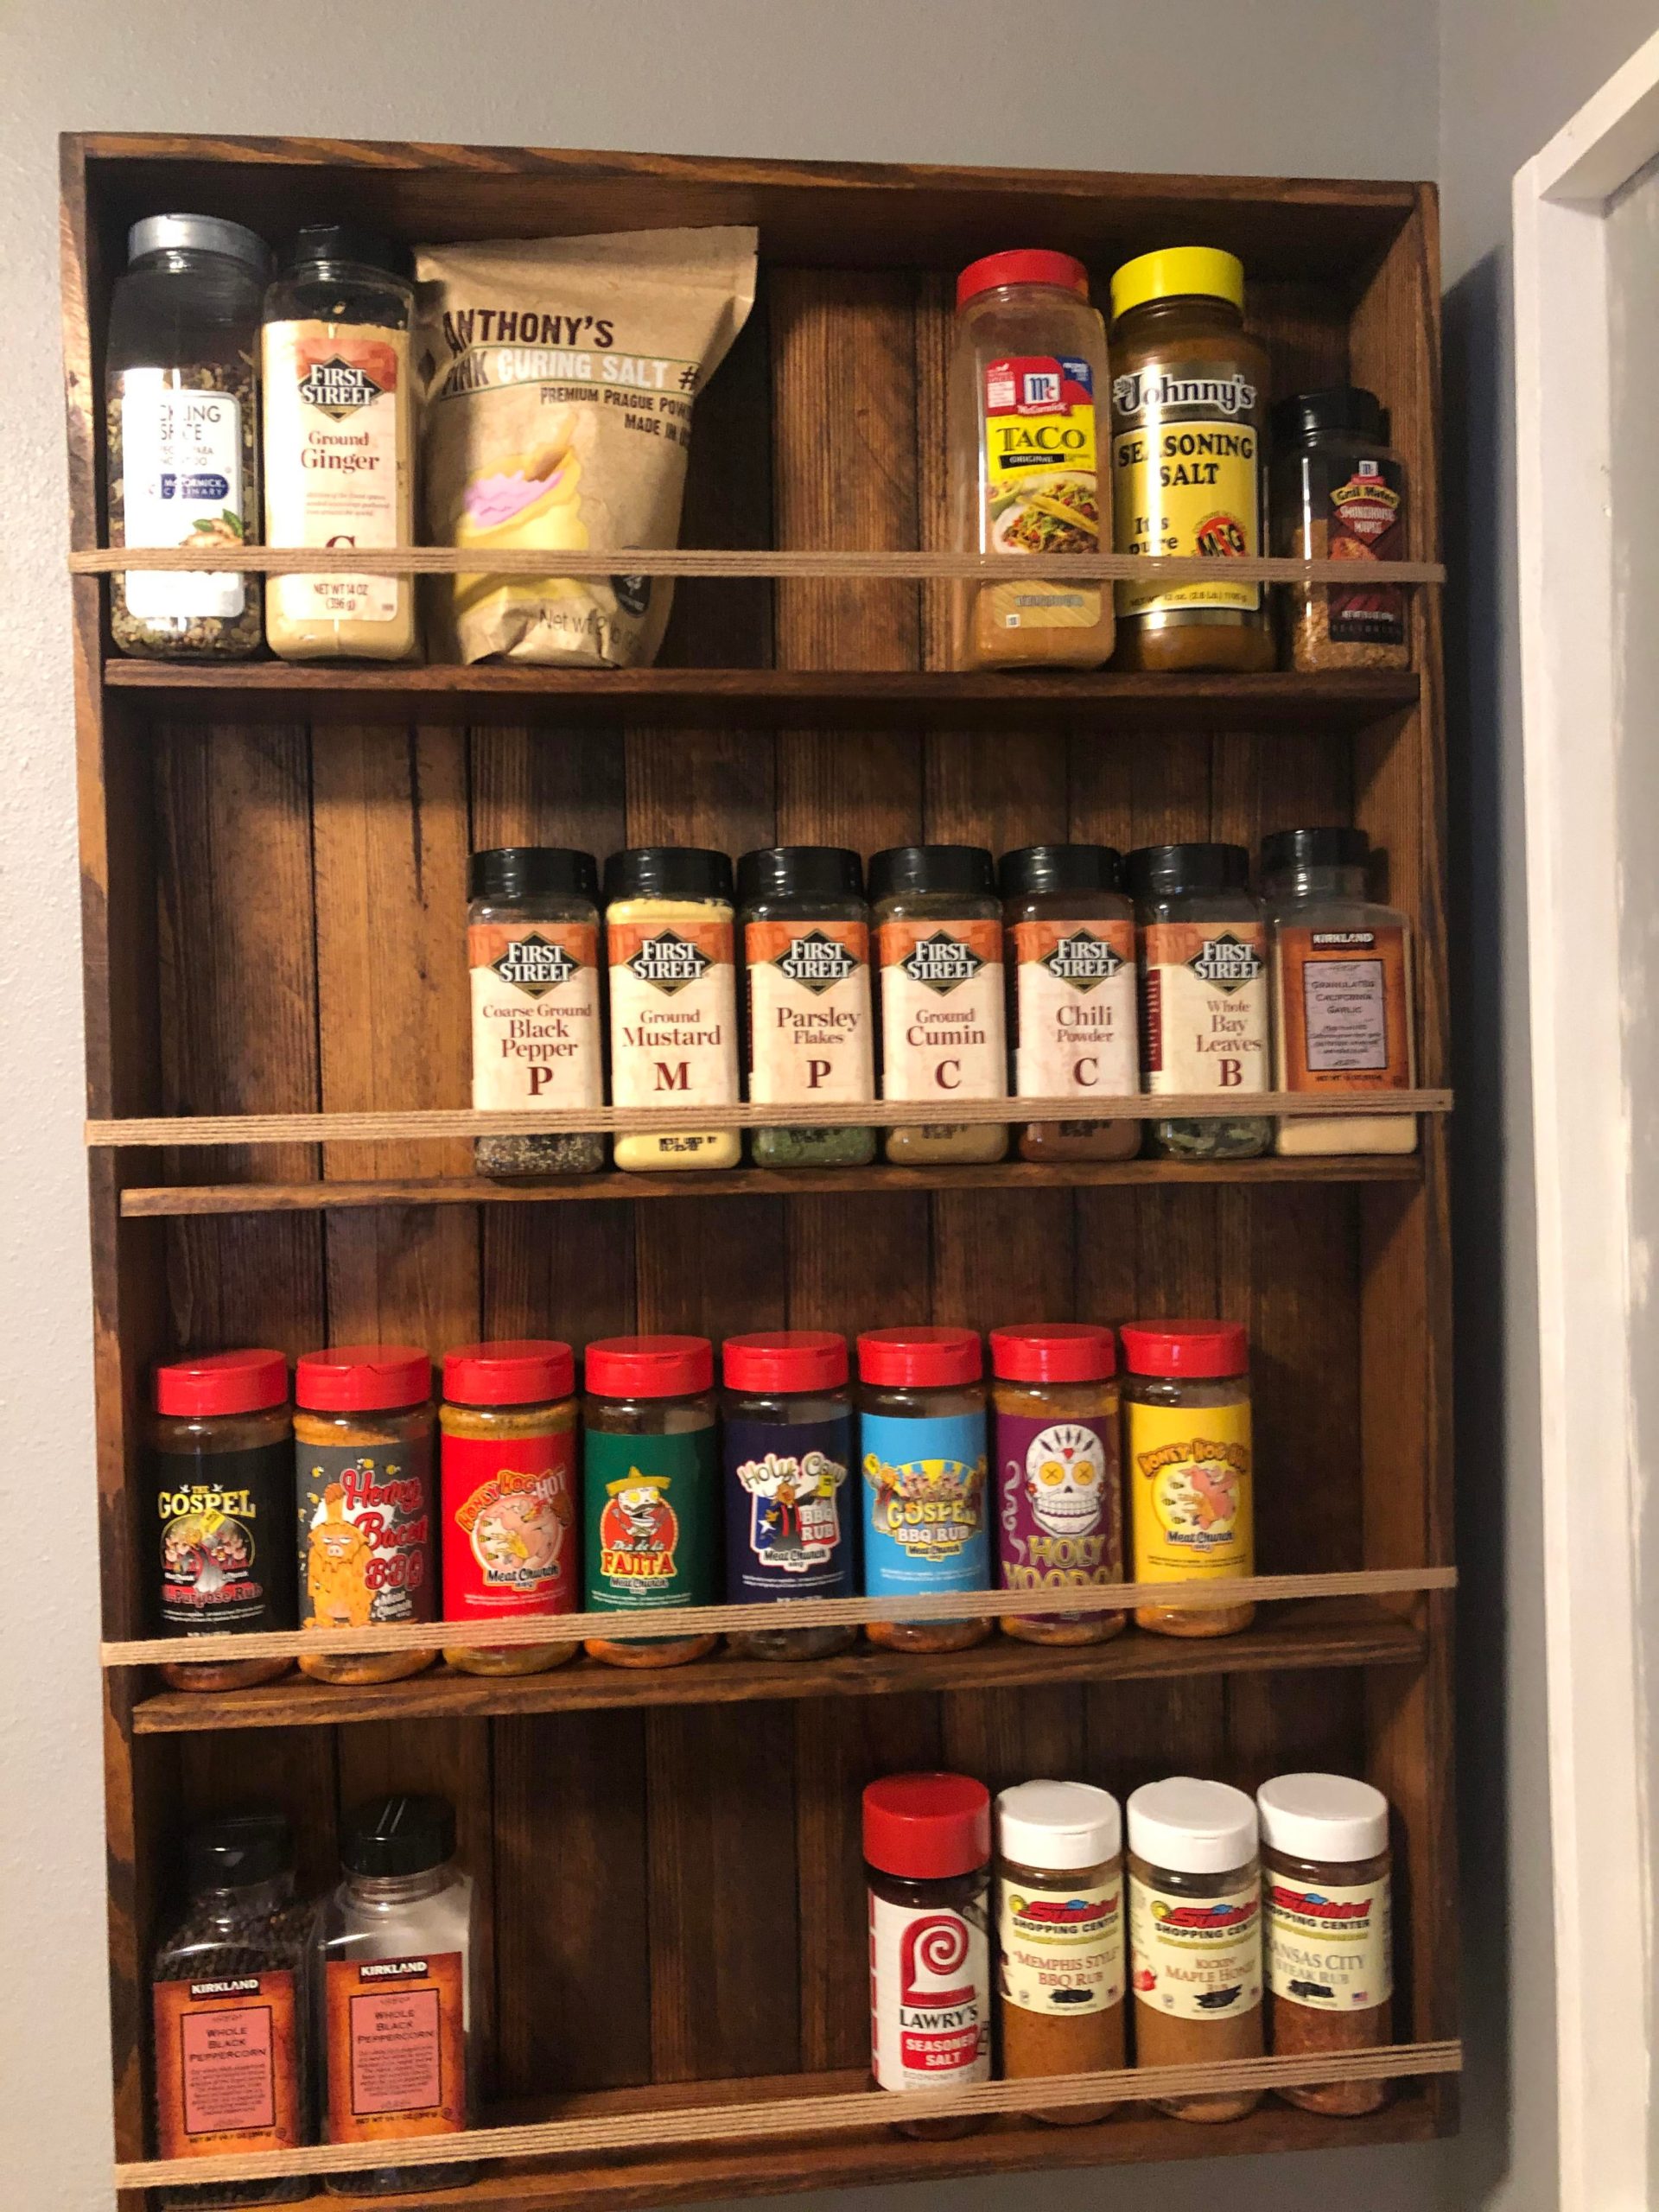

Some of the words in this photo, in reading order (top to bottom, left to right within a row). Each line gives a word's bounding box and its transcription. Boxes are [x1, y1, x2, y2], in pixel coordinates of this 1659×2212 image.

[442, 308, 614, 353] ANTHONY'S
[309, 363, 366, 386] FIRST
[498, 348, 593, 383] CURING
[602, 357, 669, 389] SALT
[302, 385, 374, 405] STREET
[540, 387, 599, 404] PREMIUM
[605, 389, 654, 410] PRAGUE
[1116, 372, 1254, 413] Johnny's
[625, 413, 661, 435] MADE
[308, 430, 370, 447] Ground
[995, 426, 1086, 452] TACO
[1118, 433, 1253, 467] SESONING
[300, 448, 380, 474] Ginger
[1160, 462, 1220, 486] SALT
[1134, 516, 1170, 535] Its
[1313, 932, 1374, 944] KIRKLAND
[508, 942, 565, 964] FIRST
[642, 939, 698, 962] FIRST
[790, 939, 846, 961] FIRST
[914, 940, 970, 962] FIRST
[1056, 938, 1111, 960] FIRST
[1202, 940, 1256, 962] FIRST
[499, 963, 574, 982] STREET
[633, 960, 706, 980] STREET
[782, 959, 854, 979] STREET
[906, 960, 978, 981] STREET
[1048, 958, 1120, 978] STREET
[1194, 961, 1262, 980] STREET
[482, 1004, 534, 1018] Coarse
[537, 1003, 593, 1018] Ground
[639, 1008, 701, 1024] Ground
[915, 1007, 976, 1024] Ground
[1056, 1005, 1114, 1027] Chili
[1206, 1000, 1252, 1013] Whole
[1327, 1006, 1362, 1014] GARLIC
[509, 1019, 570, 1039] Black
[776, 1007, 862, 1033] Parsley
[1211, 1014, 1249, 1036] Bay
[622, 1025, 721, 1047] Mustard
[793, 1030, 844, 1045] Flakes
[906, 1025, 986, 1047] Cumin
[1056, 1028, 1115, 1043] Powder
[1195, 1034, 1263, 1052] Leaves
[500, 1039, 579, 1062] Pepper
[526, 1066, 554, 1096] P
[653, 1061, 692, 1091] M
[806, 1059, 832, 1089] P
[935, 1059, 963, 1090] C
[1073, 1057, 1099, 1087] C
[1217, 1058, 1244, 1087] B
[1138, 1443, 1192, 1477] HONEY
[499, 1471, 537, 1497] HOG
[536, 1471, 567, 1504] HOT
[158, 1489, 257, 1519] GOSPEL
[887, 1498, 977, 1529] GOSPEL
[802, 1524, 835, 1542] RUB
[897, 1528, 931, 1544] BBQ
[937, 1526, 969, 1542] RUB
[1168, 1531, 1194, 1543] Meat
[764, 1550, 789, 1562] Meat
[1028, 1535, 1107, 1568] HOLY
[602, 1551, 676, 1576] FAJITA
[486, 1568, 517, 1583] Meat
[1013, 1916, 1078, 1935] SHOPPING
[1155, 1923, 1224, 1939] SHOPPING
[1321, 1918, 1371, 1930] CENTER
[360, 1961, 428, 1977] KIRKLAND
[1325, 1954, 1367, 1970] CITY
[1039, 1973, 1072, 1990] BBQ
[1166, 1965, 1216, 1983] MAPLE
[191, 1979, 259, 1995] KIRKLAND
[374, 2009, 415, 2020] WHOLE
[899, 2005, 979, 2029] LAWRY'S
[206, 2027, 248, 2037] WHOLE
[376, 2021, 413, 2031] BLACK
[207, 2038, 246, 2049] BLACK
[357, 2031, 432, 2044] PEPPERCORN
[906, 2034, 976, 2052] SEASONED
[189, 2049, 266, 2063] PEPPERCORN
[925, 2052, 962, 2067] SALT
